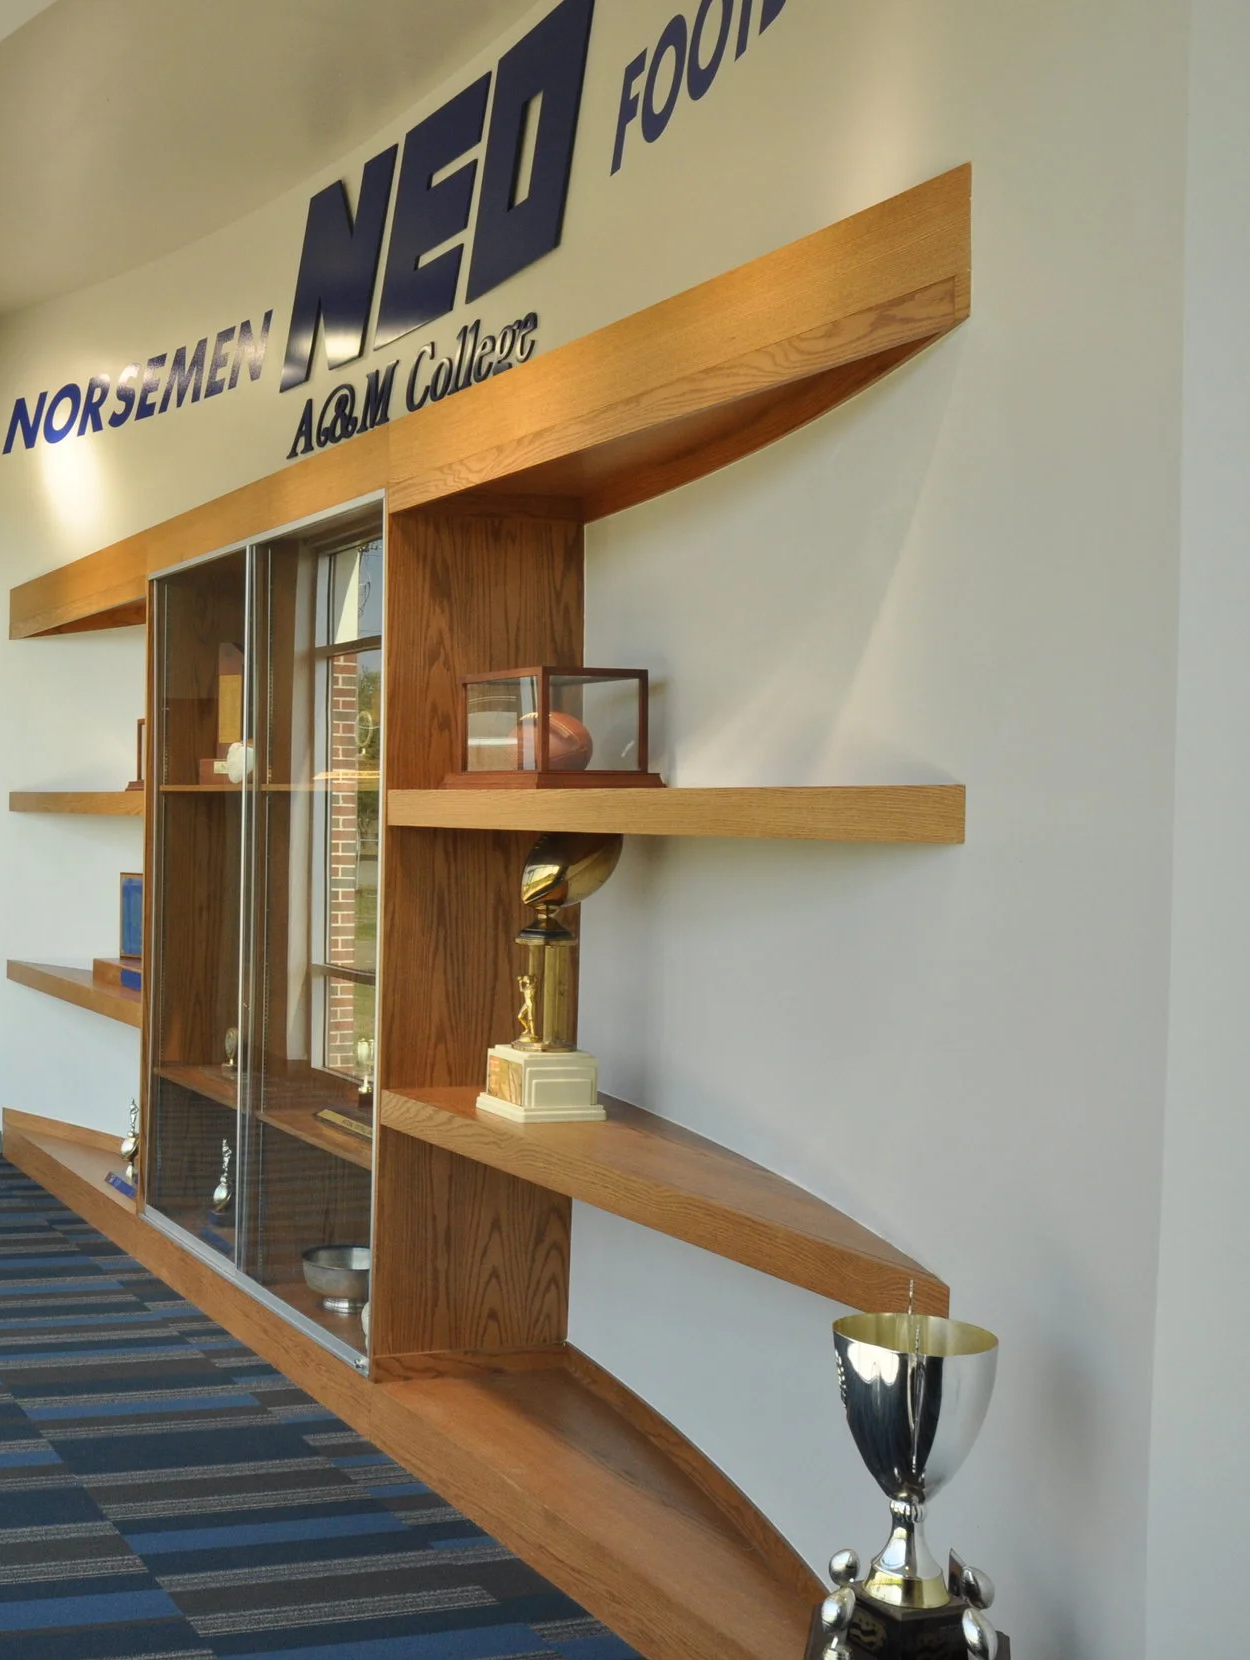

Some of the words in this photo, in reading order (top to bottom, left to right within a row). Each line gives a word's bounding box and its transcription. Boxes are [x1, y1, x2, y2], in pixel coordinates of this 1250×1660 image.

[610, 0, 787, 177] FOO
[279, 0, 595, 394] NEO
[2, 309, 273, 455] NORSEMEN
[286, 360, 400, 460] A&M
[405, 312, 538, 412] College
